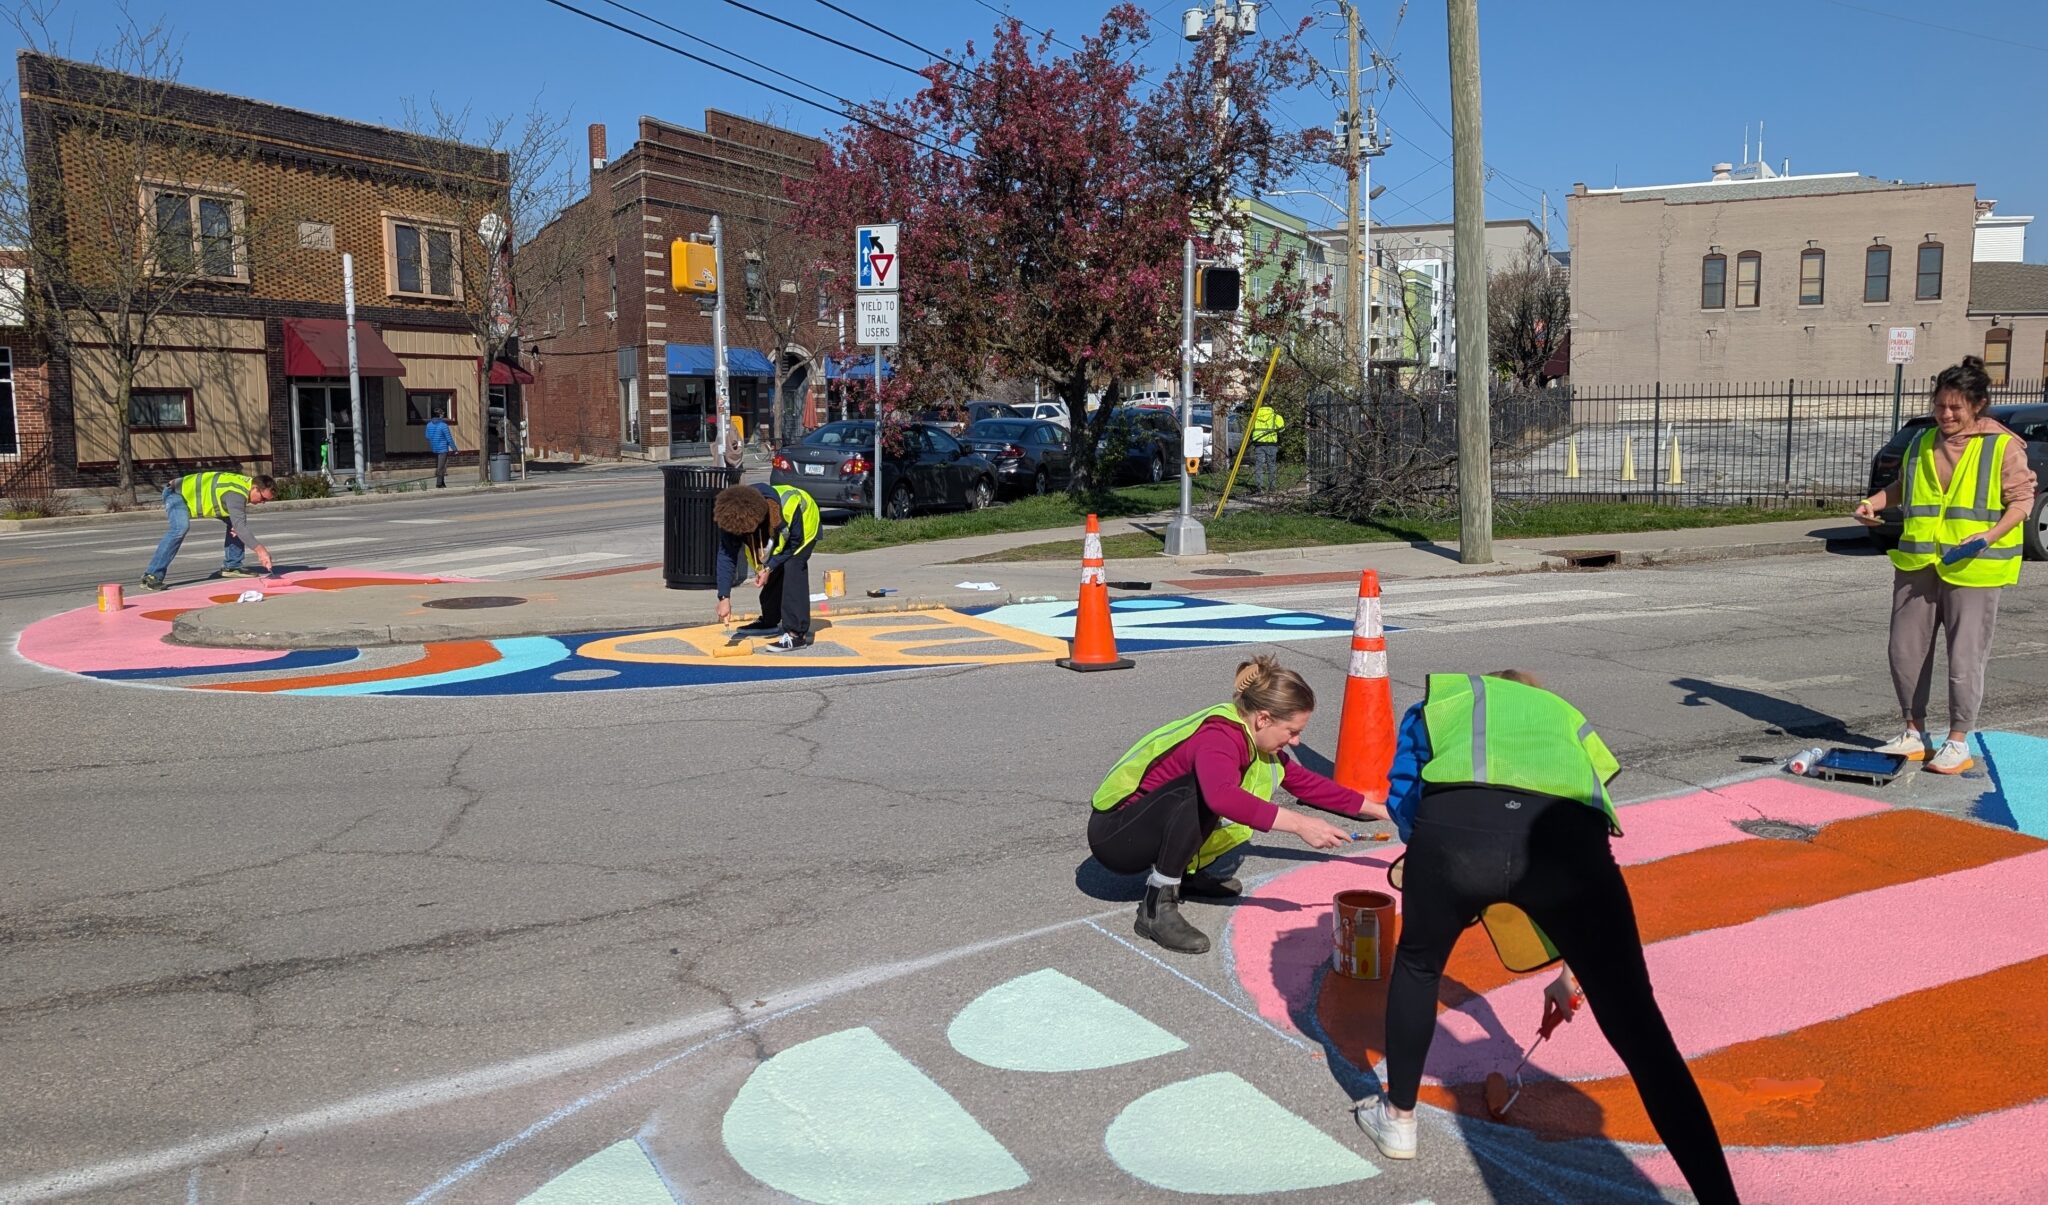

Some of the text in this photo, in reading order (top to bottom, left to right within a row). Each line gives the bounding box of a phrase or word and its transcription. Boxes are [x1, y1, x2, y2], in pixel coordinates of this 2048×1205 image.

[861, 301, 895, 311] YIELD TO
[867, 314, 888, 324] TRAIL
[865, 327, 890, 337] USERS
